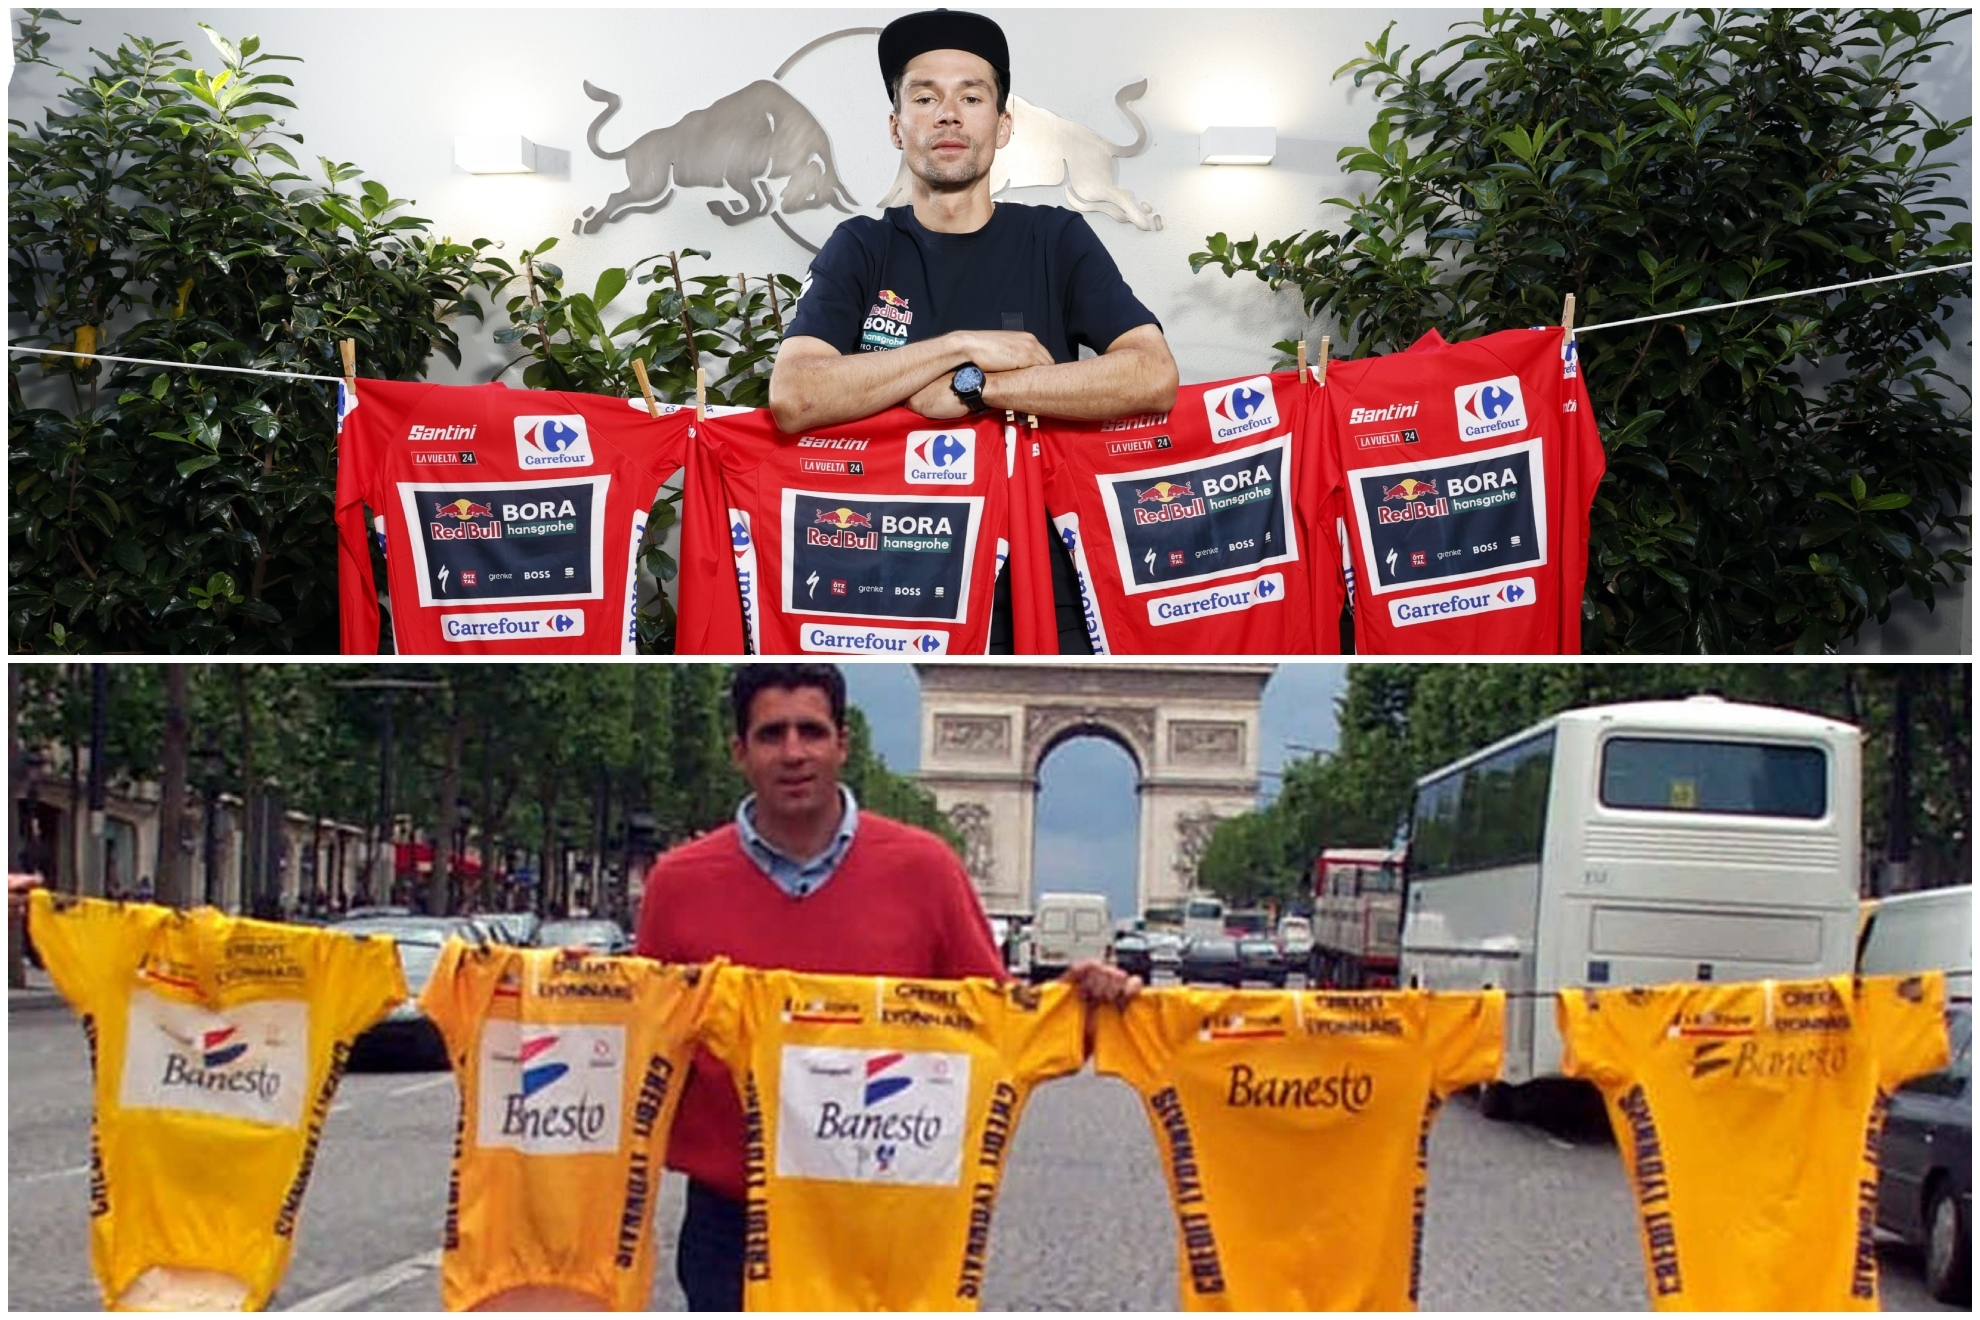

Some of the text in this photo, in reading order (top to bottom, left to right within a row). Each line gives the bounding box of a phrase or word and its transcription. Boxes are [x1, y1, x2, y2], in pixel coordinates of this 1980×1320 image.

[863, 317, 908, 337] BORA
[863, 331, 905, 346] hansgrohe
[1349, 400, 1420, 424] Santini
[1100, 411, 1169, 432] Santini
[1217, 415, 1273, 438] Carrefour
[1465, 416, 1521, 437] Carrefour
[407, 424, 477, 441] Santini
[1404, 430, 1416, 442] 24
[797, 436, 871, 451] Santini
[1157, 438, 1168, 448] 24
[462, 453, 473, 463] 24
[525, 453, 586, 466] Carrefour
[850, 462, 861, 474] 24
[911, 468, 968, 481] Carrefour
[1202, 464, 1272, 497] BORA
[1447, 467, 1518, 497] BORA
[1209, 484, 1272, 511] hansgrohe
[1453, 488, 1517, 512] hansgrohe
[502, 499, 576, 522] BORA
[507, 519, 574, 536] hansgrohe
[881, 515, 953, 535] BORA
[883, 537, 950, 551] hansgrohe
[1228, 538, 1255, 552] BOSS
[1472, 541, 1498, 555] BOSS
[1194, 547, 1219, 559] grenke
[1436, 548, 1462, 560] grenke
[488, 573, 513, 582] grenke
[524, 570, 551, 580] BOSS
[858, 585, 884, 594] grenke
[894, 586, 921, 596] BOSS
[1157, 589, 1251, 619] Carrefour
[1397, 592, 1490, 620] Carrefour
[447, 617, 540, 637] Carrefour
[809, 629, 908, 652] Carrefour
[162, 1052, 281, 1100] Banesto
[1227, 1061, 1373, 1113] Banesto
[816, 1102, 943, 1148] Banesto
